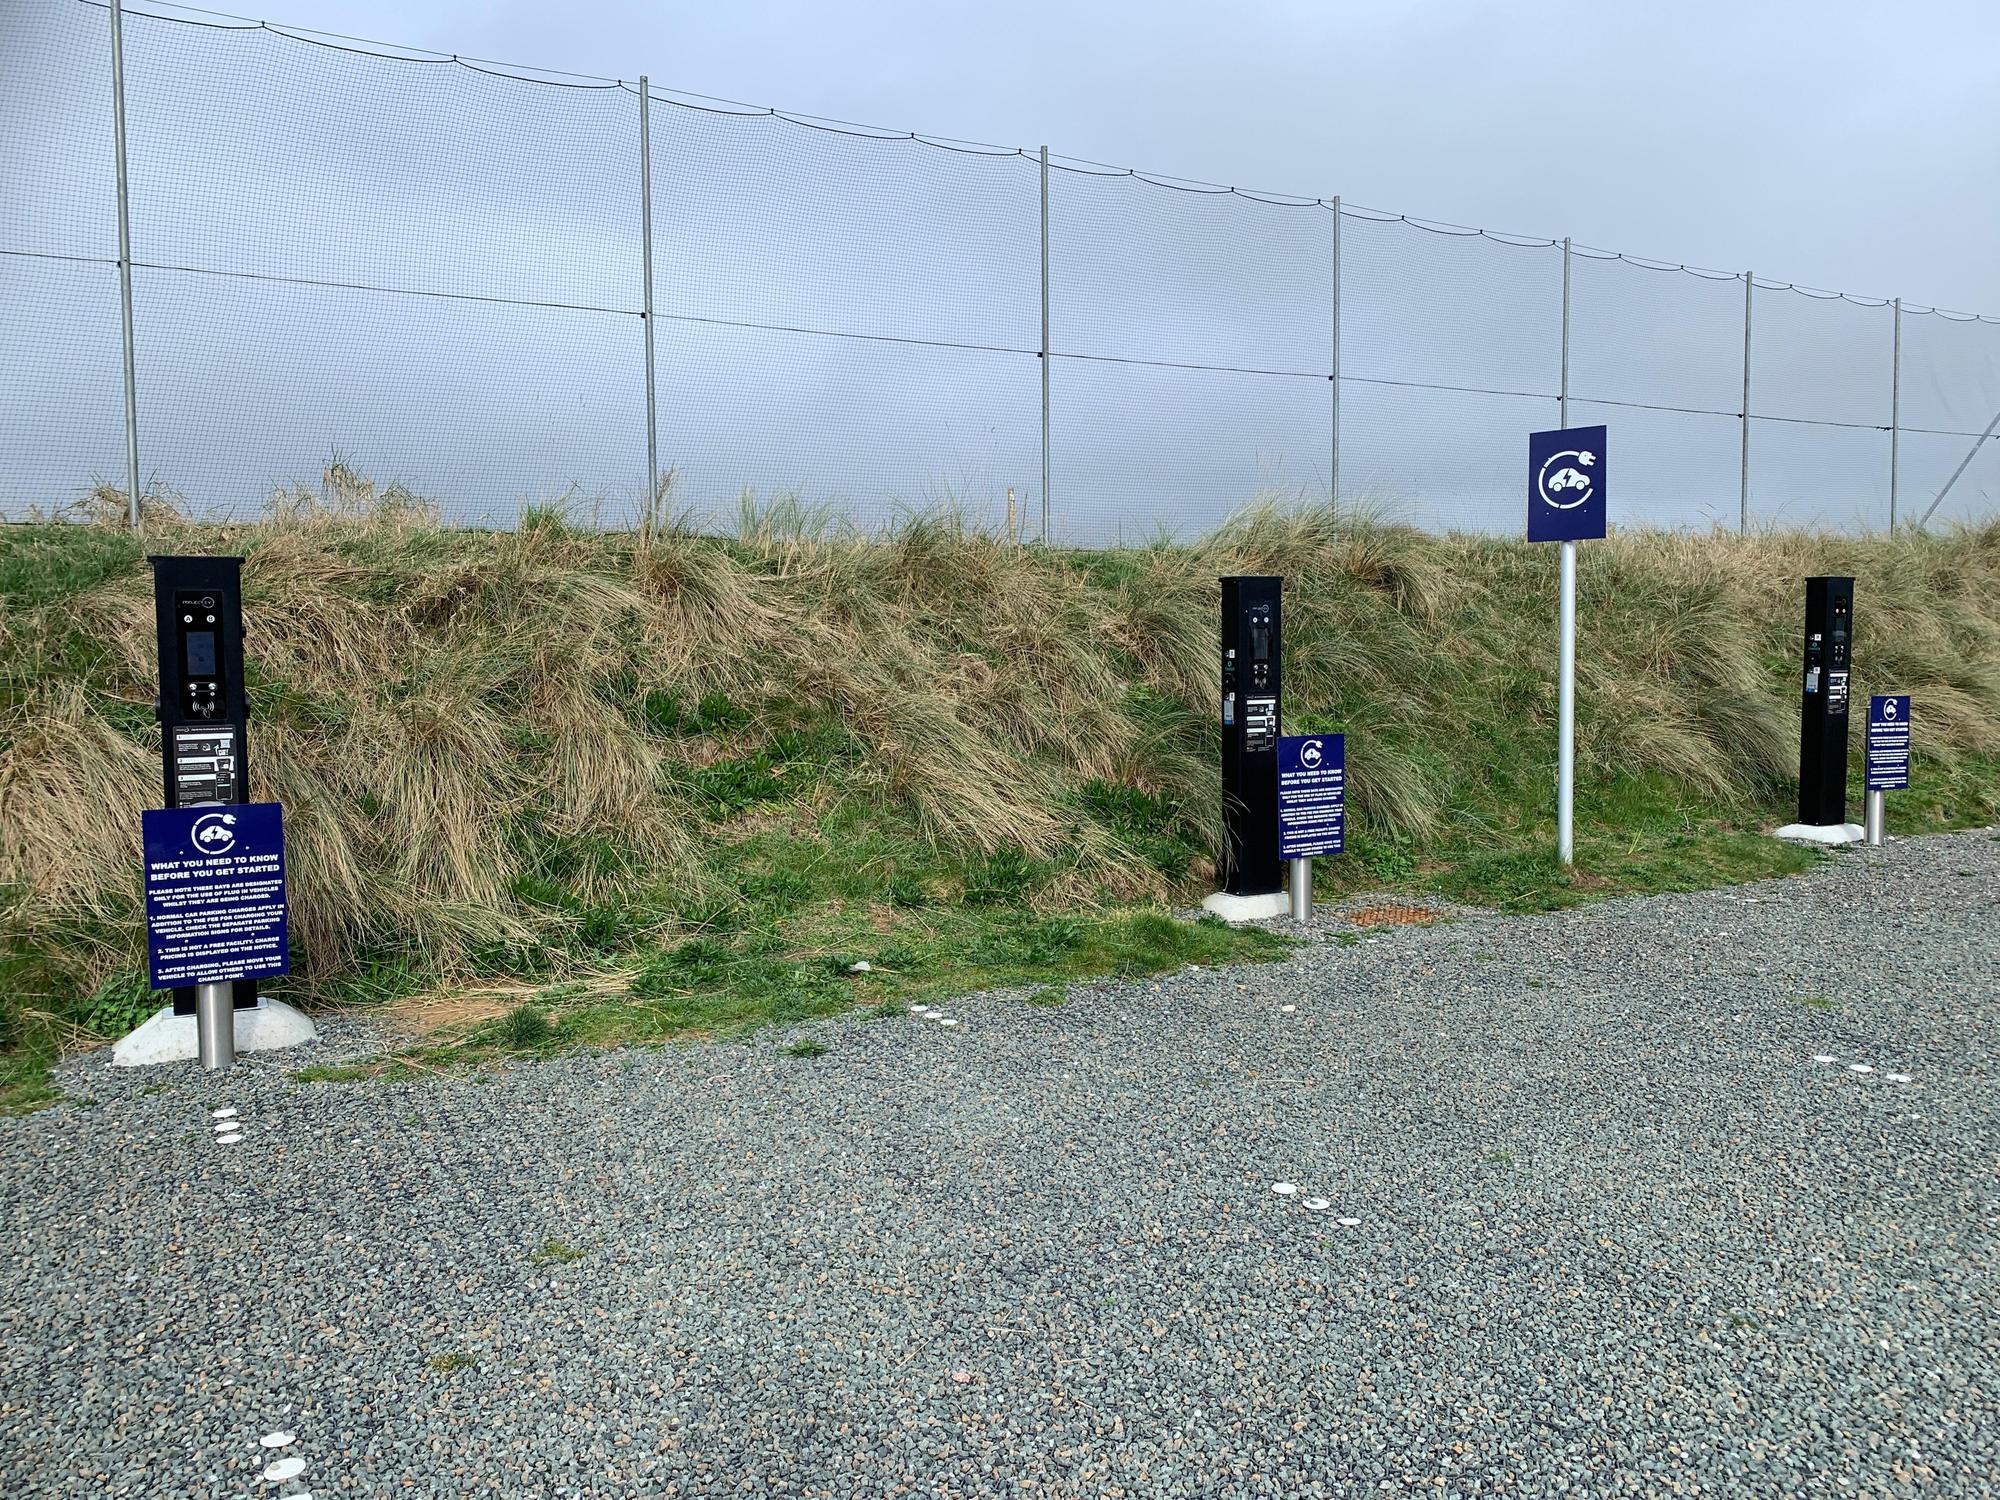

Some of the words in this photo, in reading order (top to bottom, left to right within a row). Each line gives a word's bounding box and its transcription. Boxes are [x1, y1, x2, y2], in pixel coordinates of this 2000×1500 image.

[151, 862, 180, 870] WHAT
[182, 860, 203, 868] YOU
[206, 858, 232, 866] NEED
[250, 854, 278, 862] KNOW
[151, 871, 190, 881] BEFORE
[237, 864, 280, 874] STARTED
[166, 930, 210, 940] INFORMATION
[195, 948, 229, 956] DISPLAYED
[186, 962, 222, 970] CHARGING,
